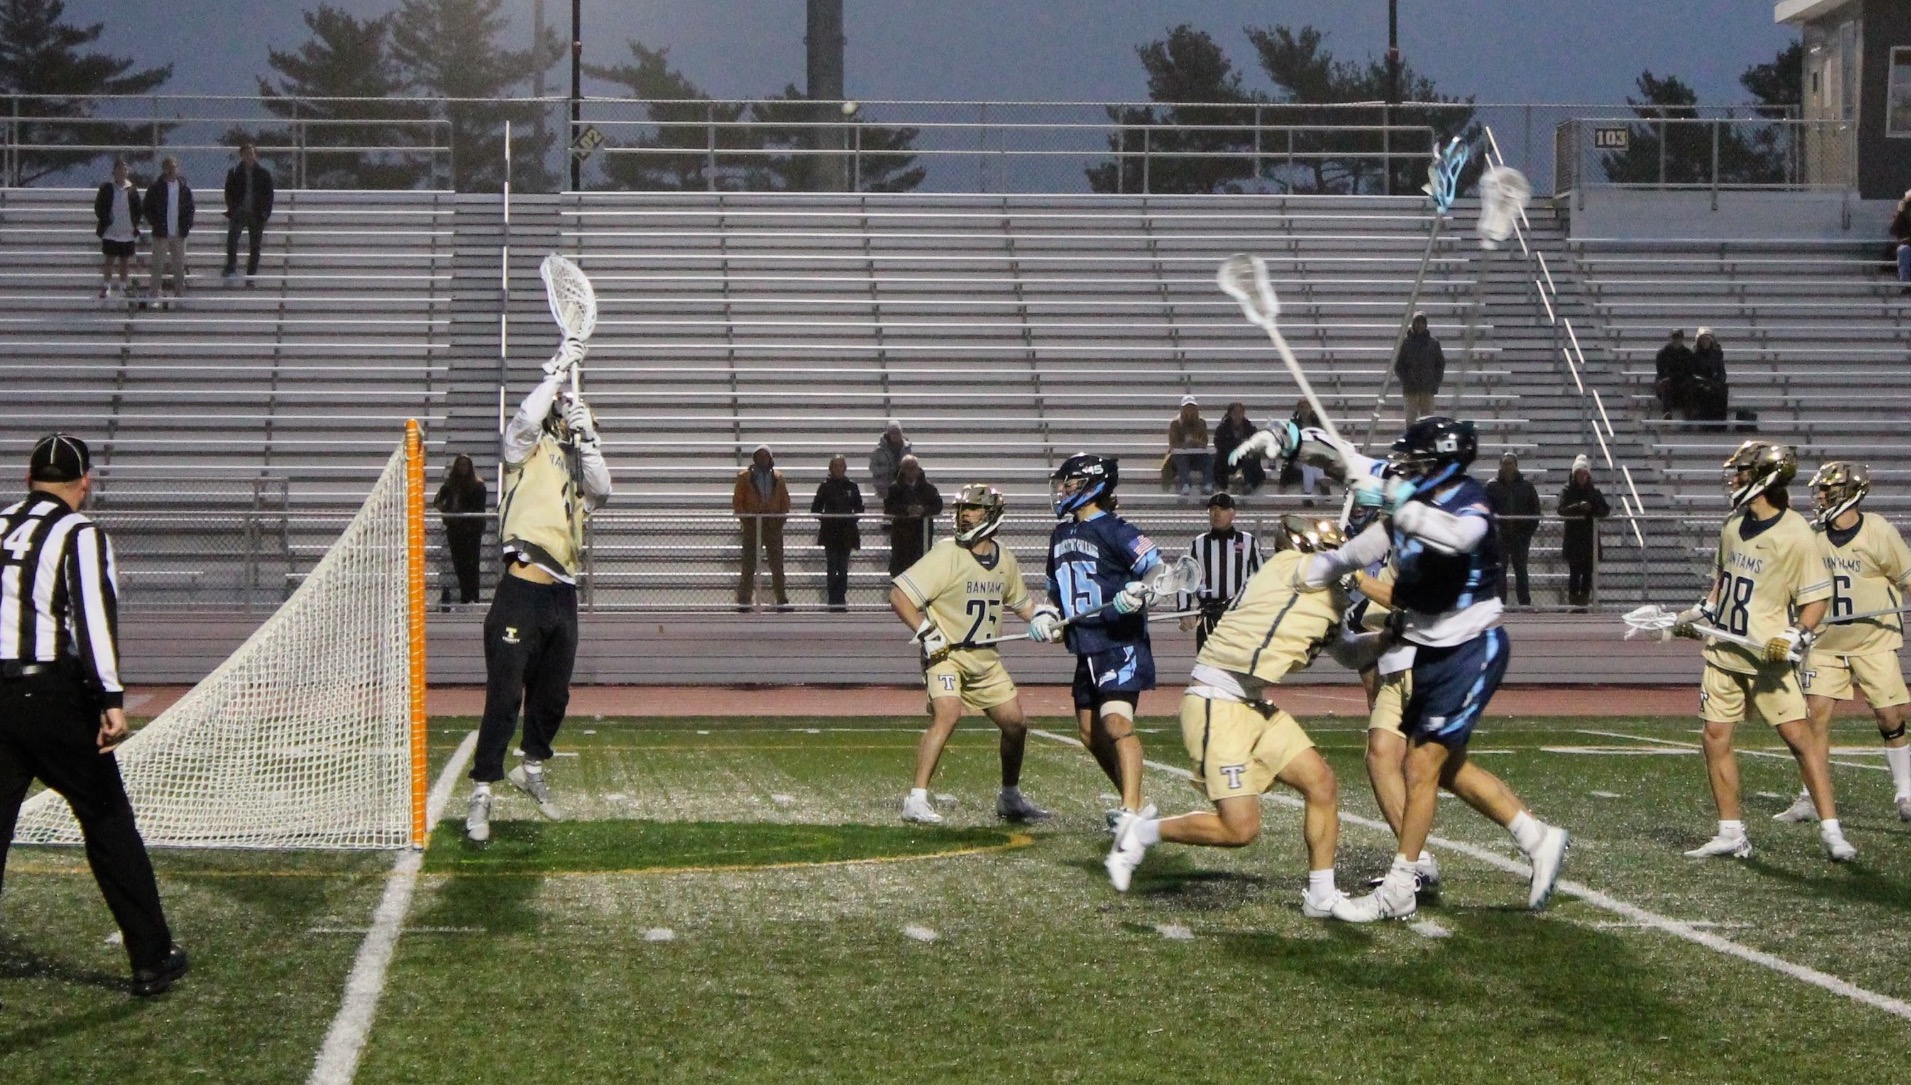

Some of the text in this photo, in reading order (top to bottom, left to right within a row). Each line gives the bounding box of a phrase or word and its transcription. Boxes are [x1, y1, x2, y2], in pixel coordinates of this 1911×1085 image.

[1597, 130, 1626, 146] 103
[0, 517, 42, 560] 4
[1728, 550, 1762, 574] NTAMS
[1055, 560, 1103, 619] 15
[1716, 570, 1754, 637] 28
[937, 674, 956, 691] T
[1220, 764, 1246, 790] T
